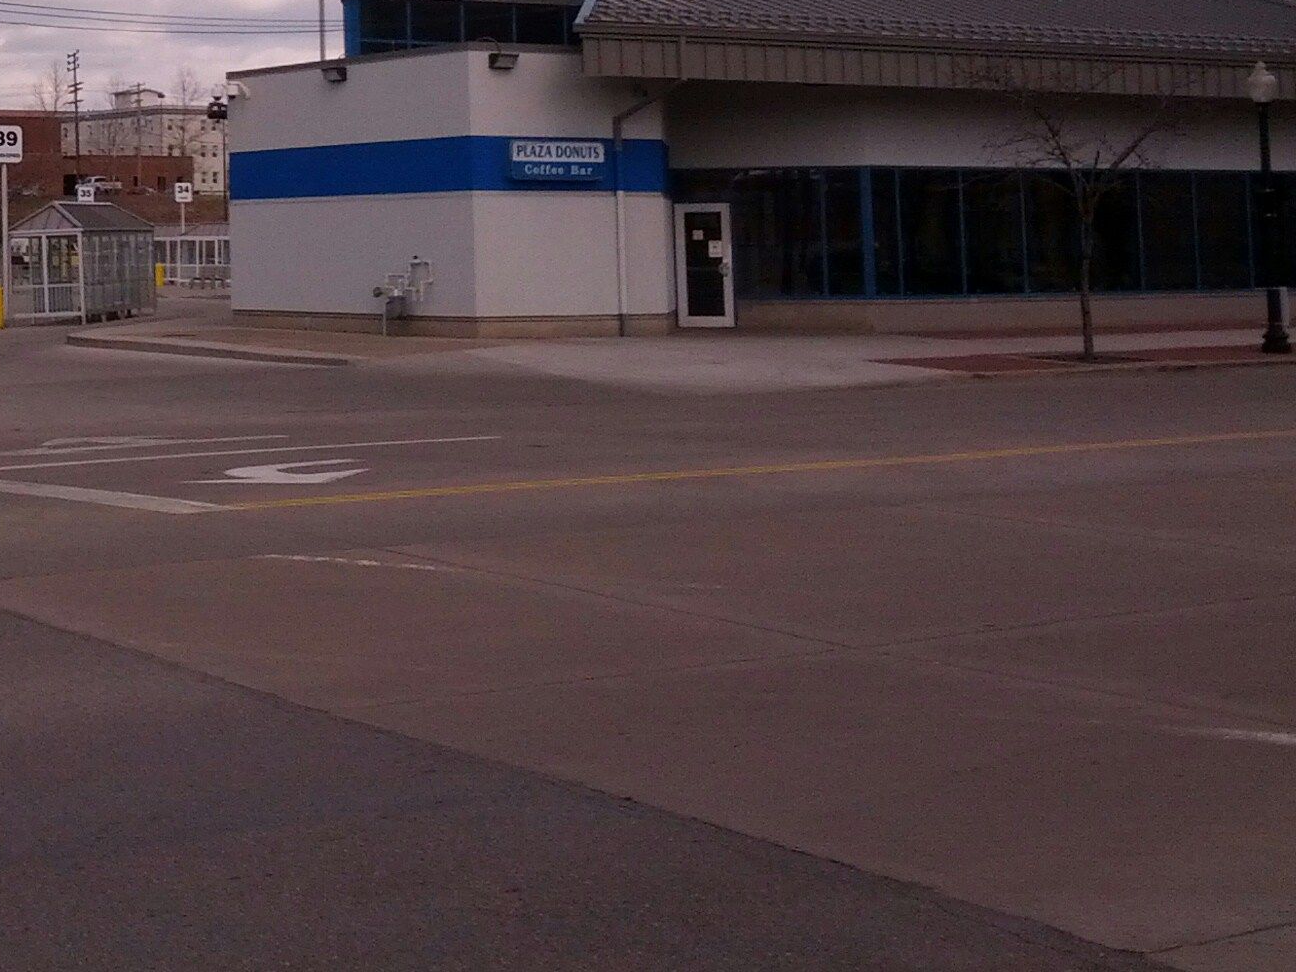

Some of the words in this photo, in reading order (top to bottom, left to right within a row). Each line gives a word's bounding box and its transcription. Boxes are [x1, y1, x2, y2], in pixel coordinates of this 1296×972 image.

[516, 145, 552, 158] PLAZA
[555, 145, 600, 159] DONUTS
[524, 164, 565, 176] Coffee
[570, 165, 593, 176] Bar
[80, 189, 92, 198] 35
[177, 185, 190, 194] 34
